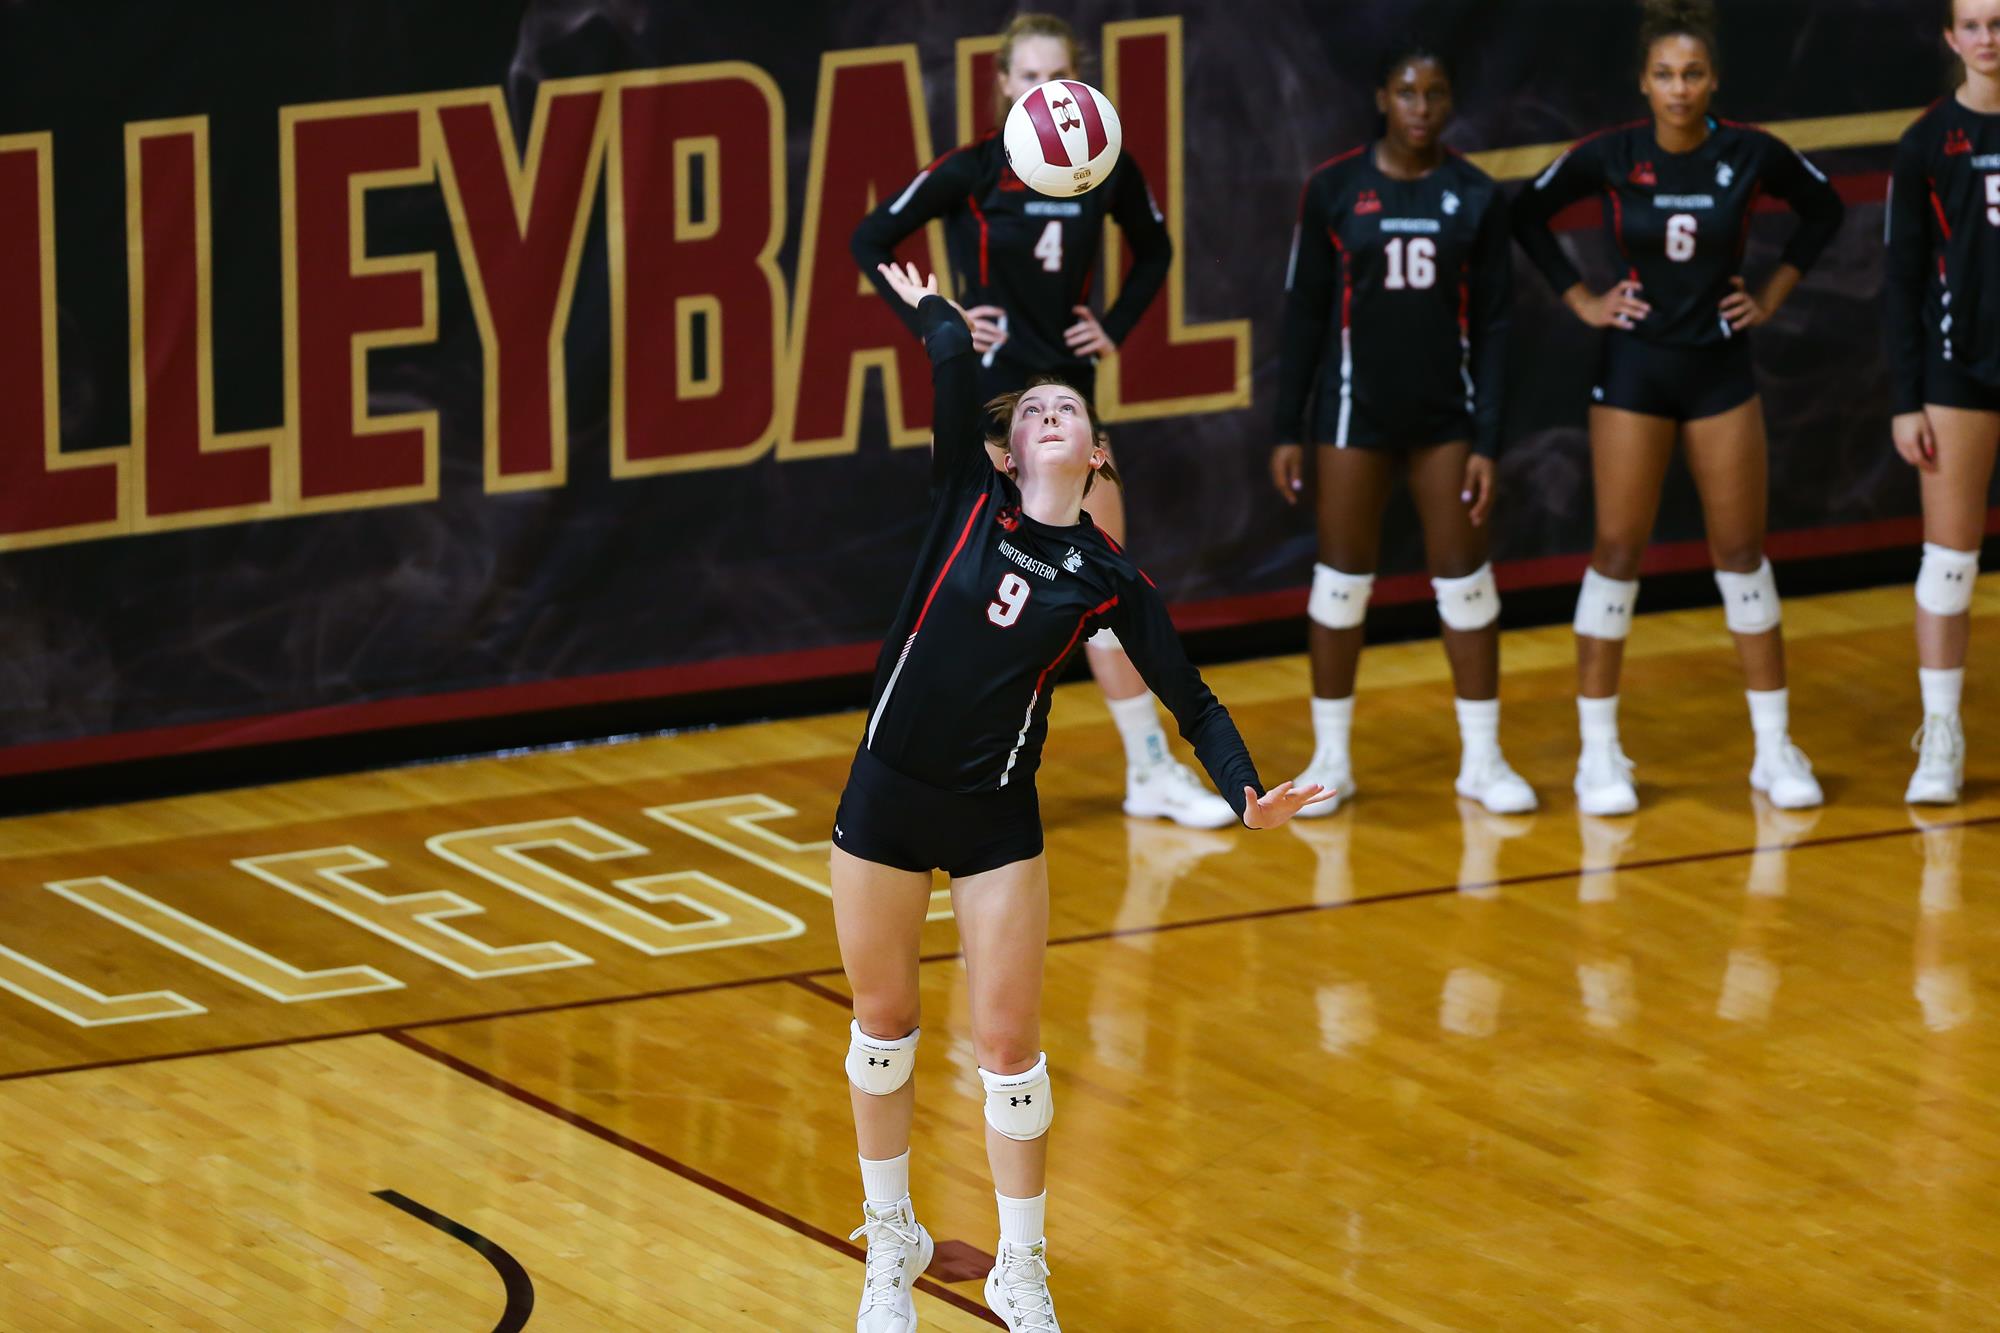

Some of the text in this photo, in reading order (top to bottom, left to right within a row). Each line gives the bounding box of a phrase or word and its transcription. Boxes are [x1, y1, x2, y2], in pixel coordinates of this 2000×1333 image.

[1033, 219, 1063, 273] 4
[1384, 236, 1437, 290] 16
[1665, 213, 1698, 263] 6
[0, 16, 1252, 552] LLEYBAL
[998, 539, 1058, 582] NORTHEASTERN
[986, 572, 1031, 628] 9
